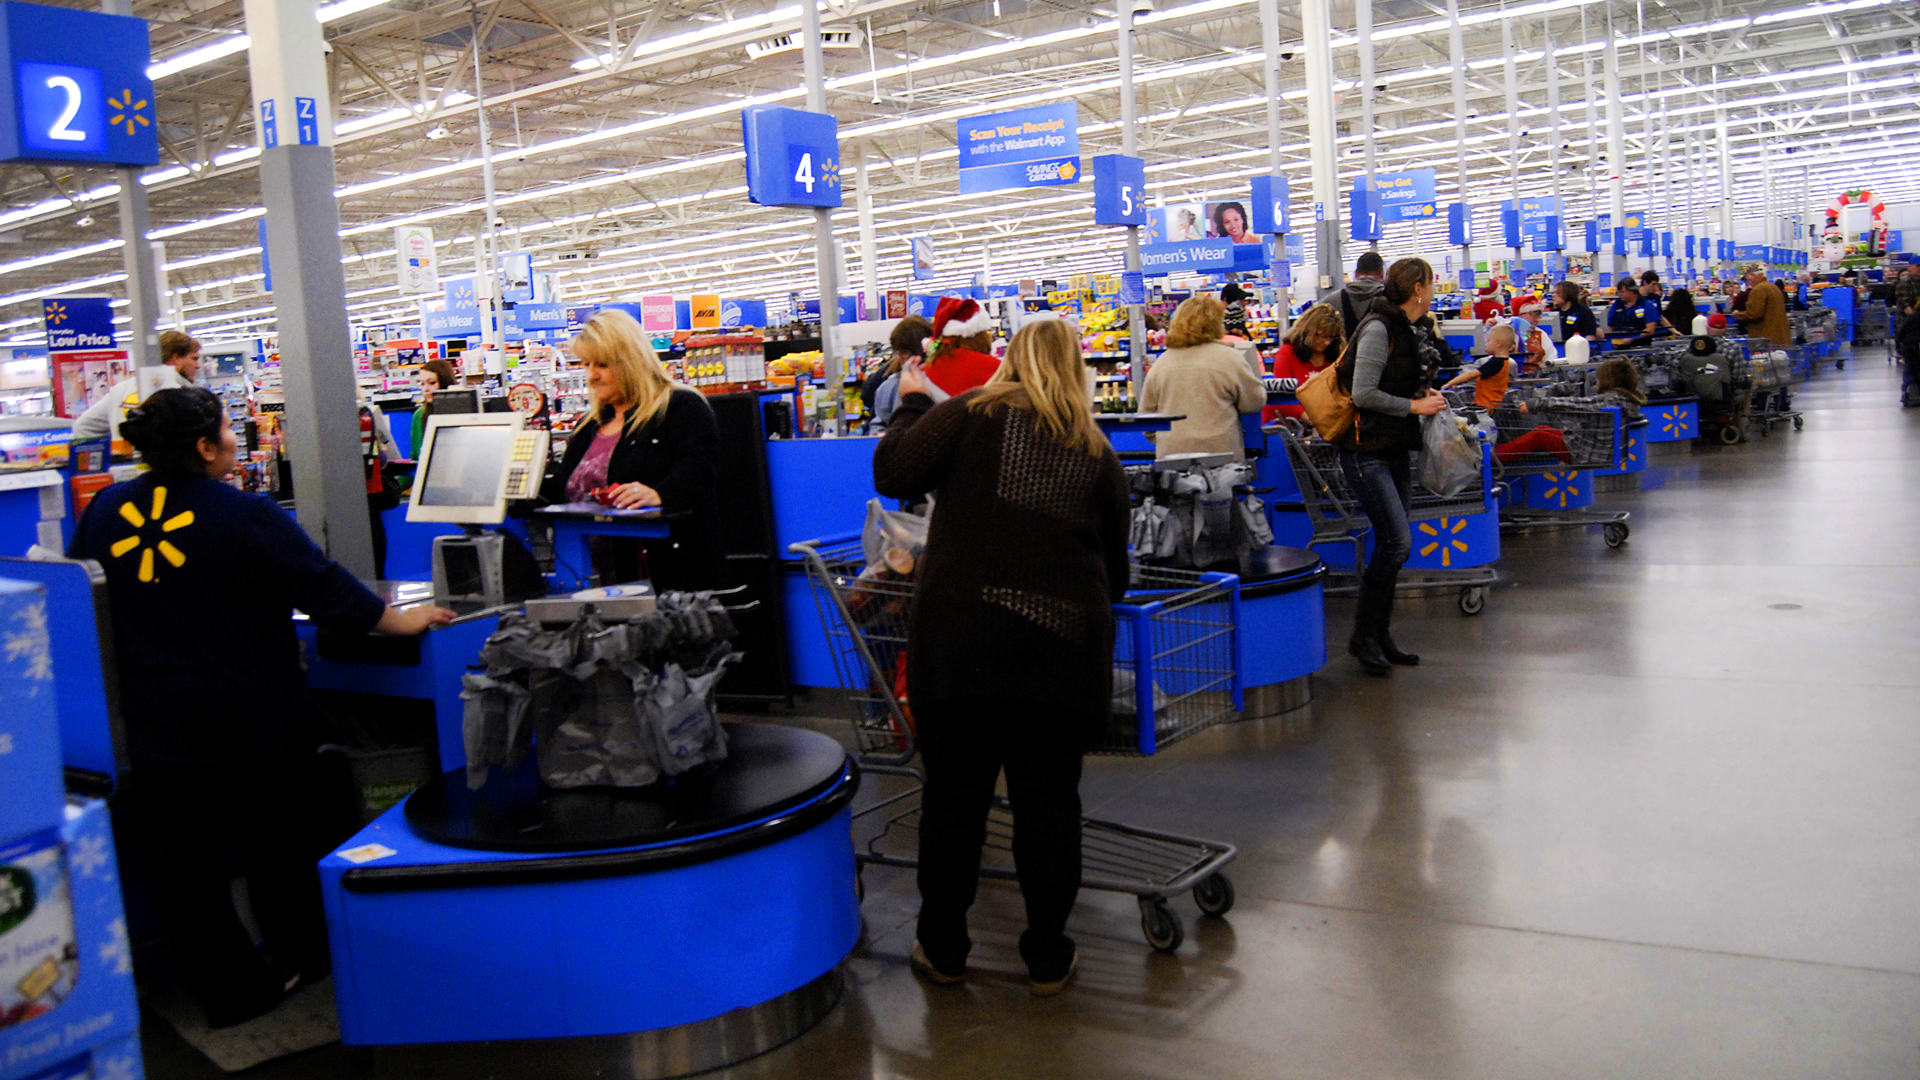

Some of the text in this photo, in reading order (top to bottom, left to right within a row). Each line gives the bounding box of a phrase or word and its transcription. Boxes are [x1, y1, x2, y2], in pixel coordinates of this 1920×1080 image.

[46, 76, 86, 141] 2
[262, 101, 274, 122] Z
[299, 100, 314, 118] Z
[264, 130, 273, 144] 1
[303, 125, 312, 142] 1
[970, 118, 1065, 141] Scan Your Receipt
[970, 134, 1065, 155] with the Walmart App
[794, 152, 816, 193] 4
[1026, 162, 1060, 175] SAVINGS
[1376, 177, 1412, 189] You Get
[1121, 185, 1133, 217] 5
[1274, 201, 1282, 226] 6
[1368, 212, 1376, 234] 7
[1141, 247, 1228, 266] Women's Wear
[449, 315, 475, 328] Wear
[529, 310, 559, 321] Men's
[50, 333, 110, 347] Low Price
